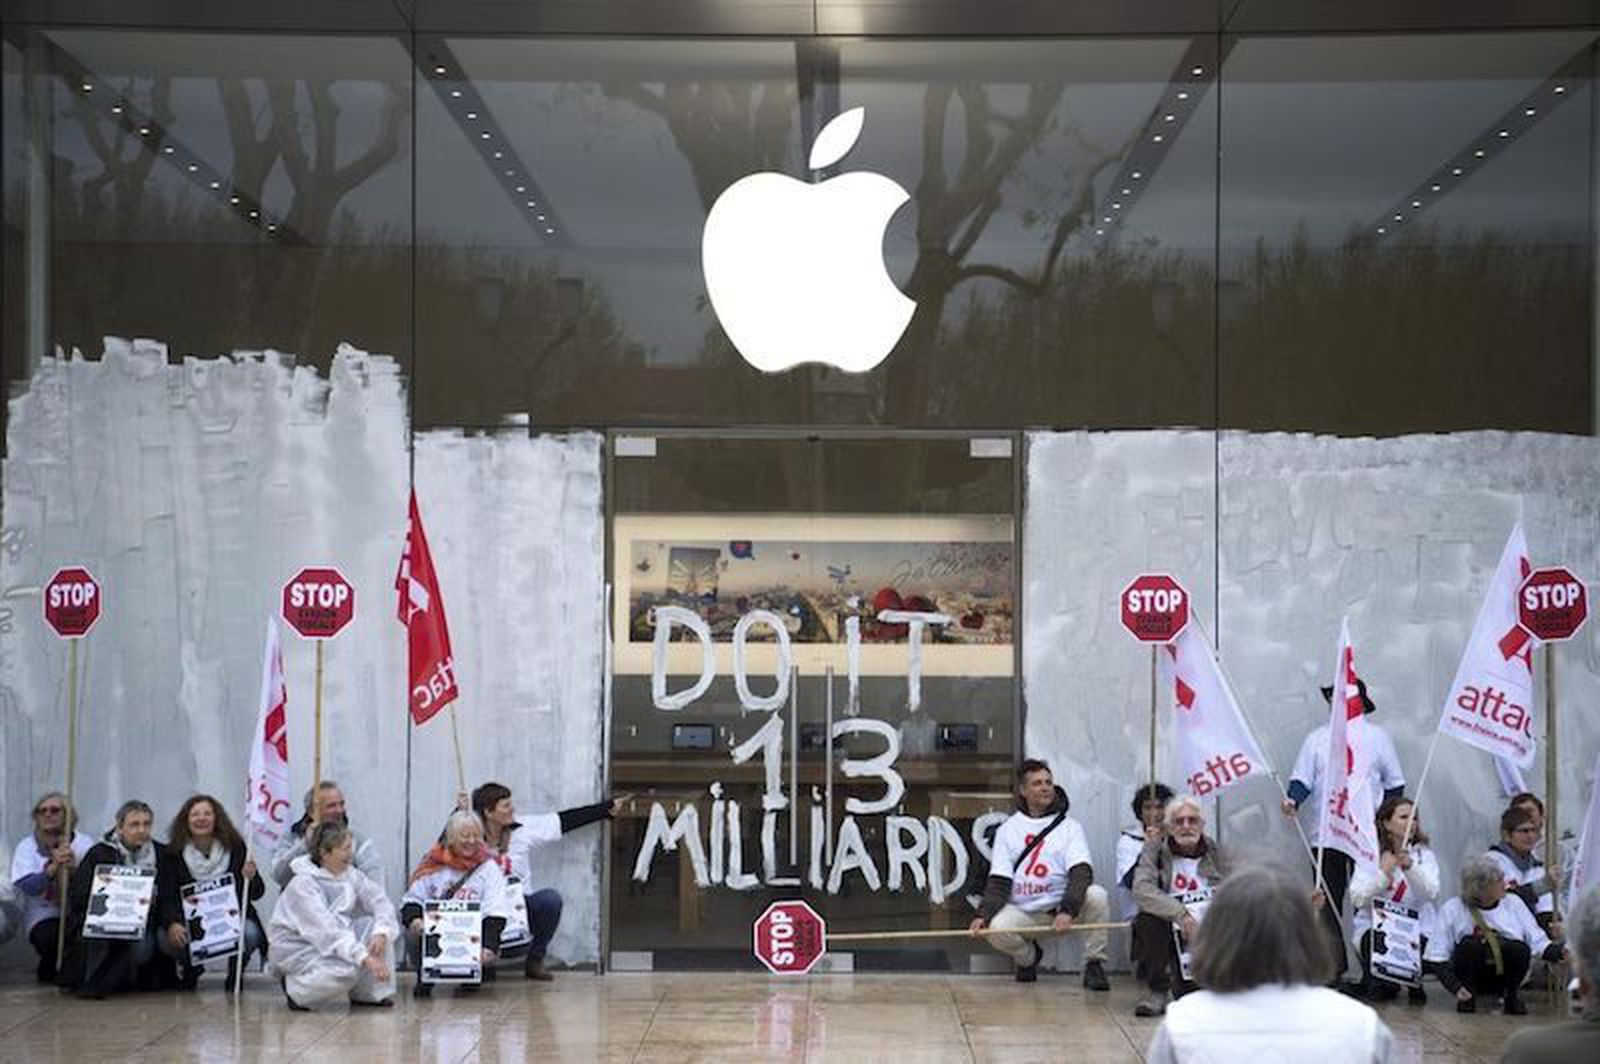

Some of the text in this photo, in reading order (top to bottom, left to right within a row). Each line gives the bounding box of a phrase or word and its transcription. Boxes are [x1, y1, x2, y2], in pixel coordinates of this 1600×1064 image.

[50, 582, 96, 608] STOP
[290, 582, 349, 608] STOP
[1128, 589, 1183, 613] STOP
[1524, 583, 1580, 611] STOP
[770, 910, 795, 965] STOP
